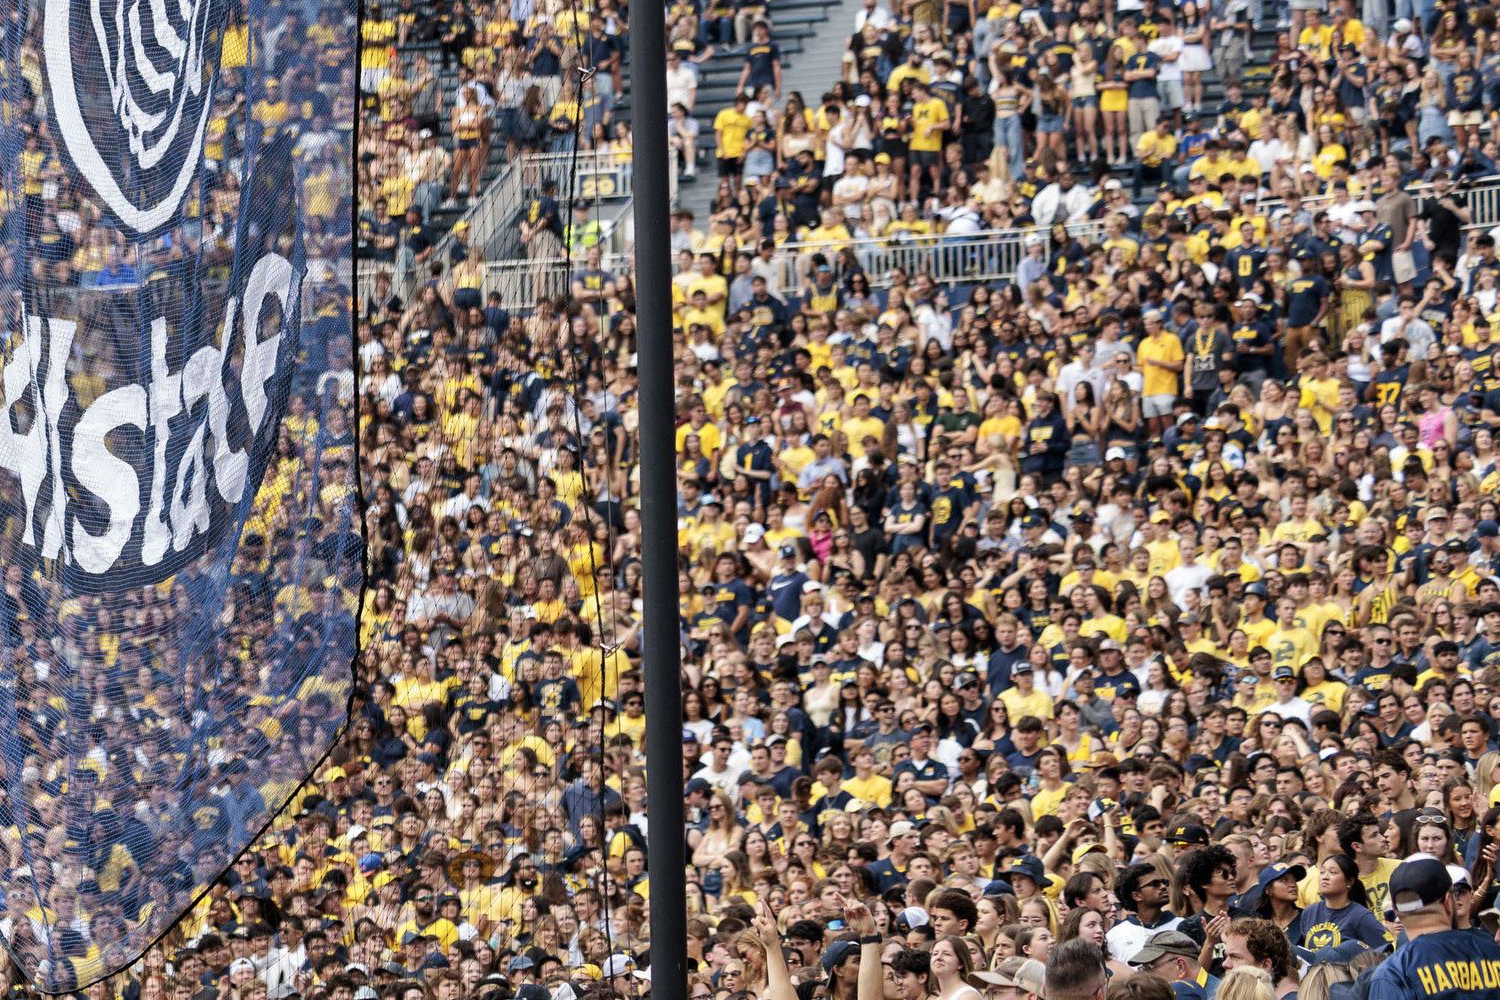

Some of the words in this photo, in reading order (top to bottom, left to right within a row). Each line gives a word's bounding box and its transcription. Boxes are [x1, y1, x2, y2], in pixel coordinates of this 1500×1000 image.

[1136, 56, 1148, 71] 7
[582, 178, 615, 197] 29
[1240, 256, 1252, 276] 0
[1377, 383, 1402, 408] 37
[819, 417, 836, 431] M
[744, 453, 753, 471] 1
[1272, 641, 1293, 664] 2
[1176, 827, 1185, 835] M
